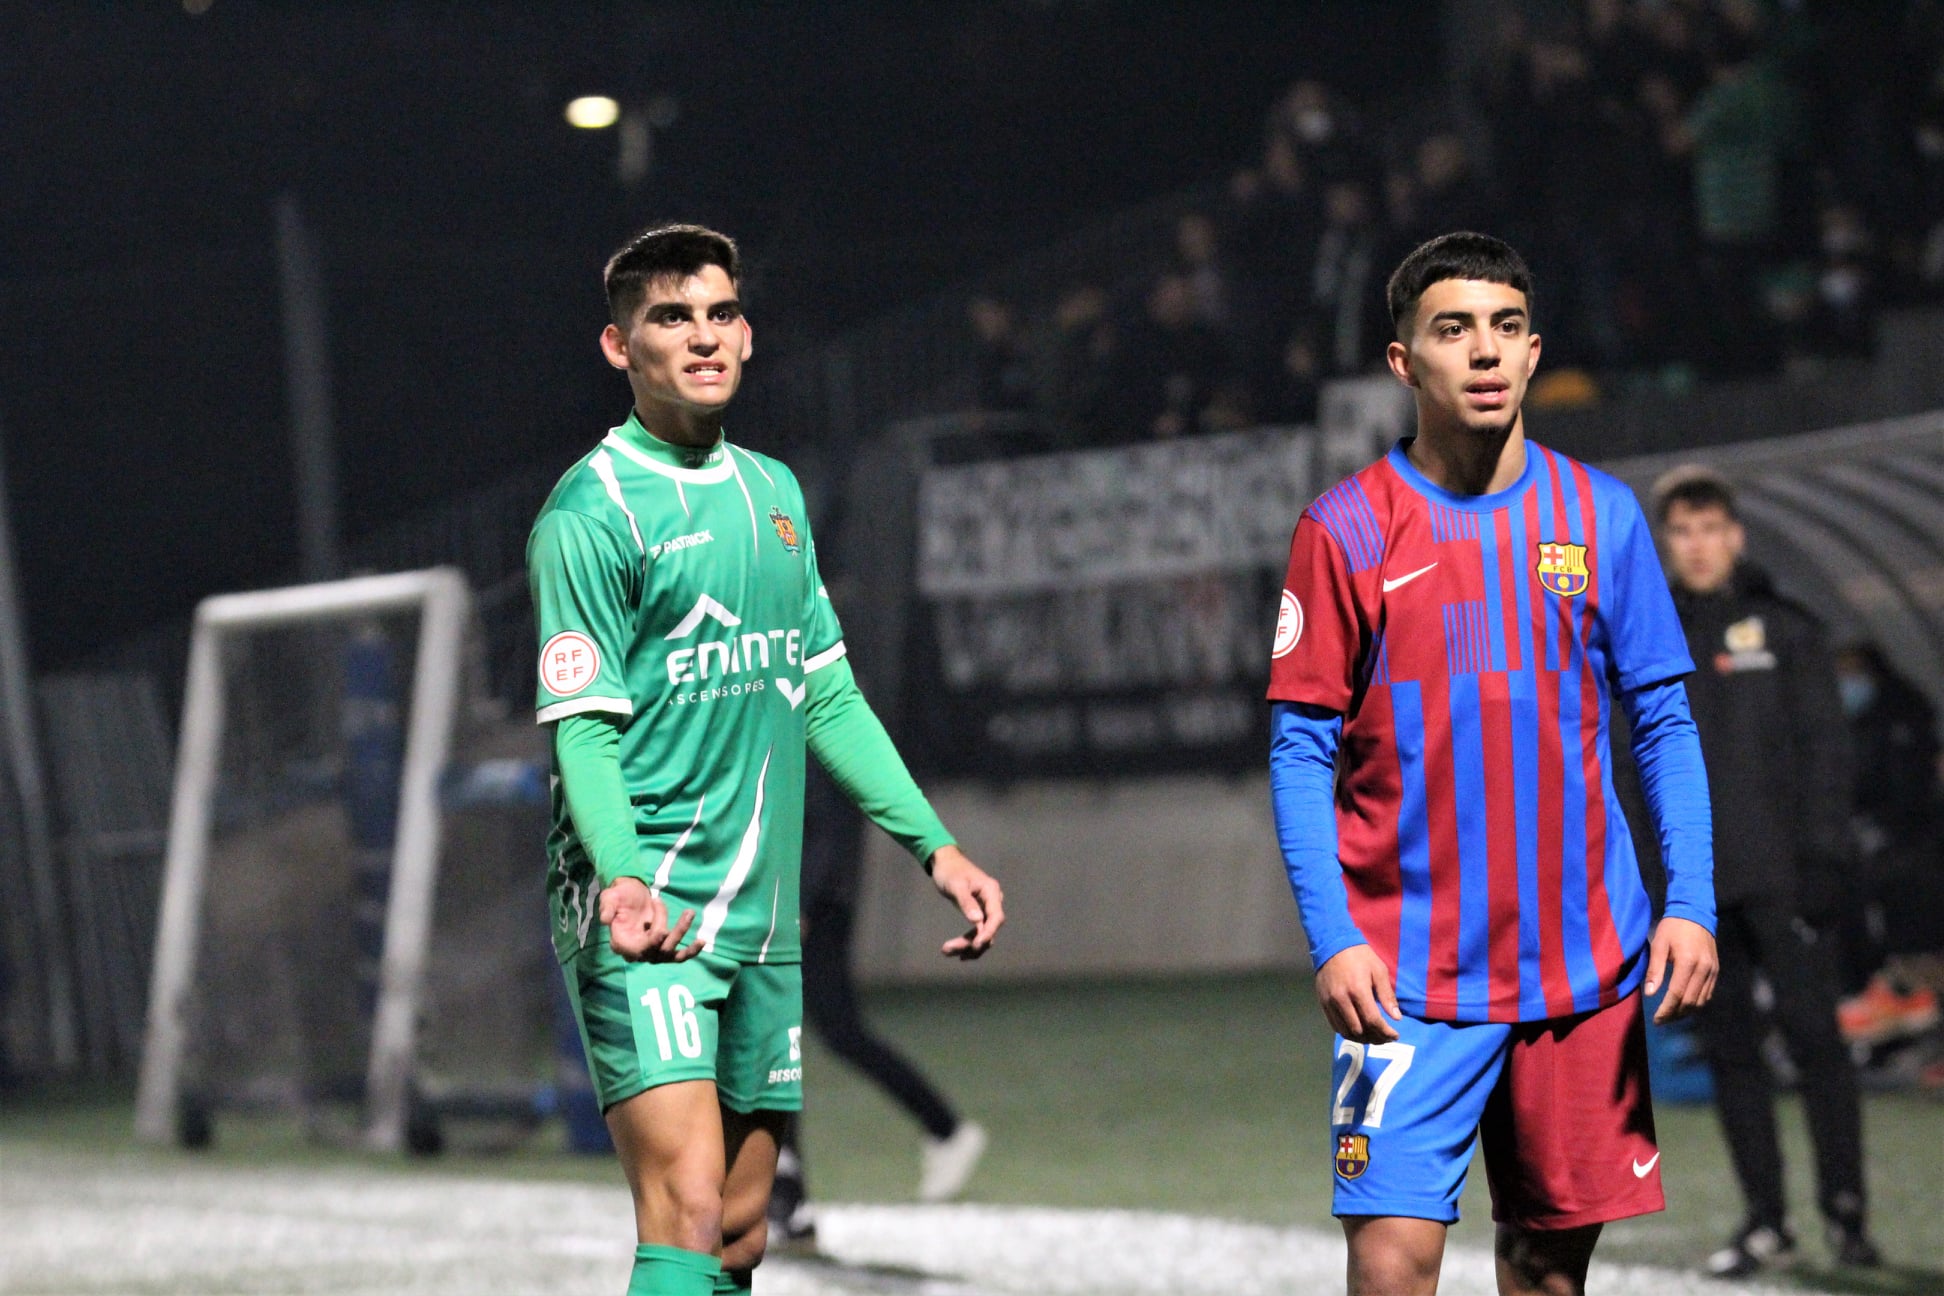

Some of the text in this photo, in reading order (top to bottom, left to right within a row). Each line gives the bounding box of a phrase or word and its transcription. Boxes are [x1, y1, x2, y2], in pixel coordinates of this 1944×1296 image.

[663, 529, 715, 555] PATRICK
[1553, 565, 1573, 573] FCB
[640, 983, 703, 1062] 16
[1332, 1038, 1416, 1129] 27
